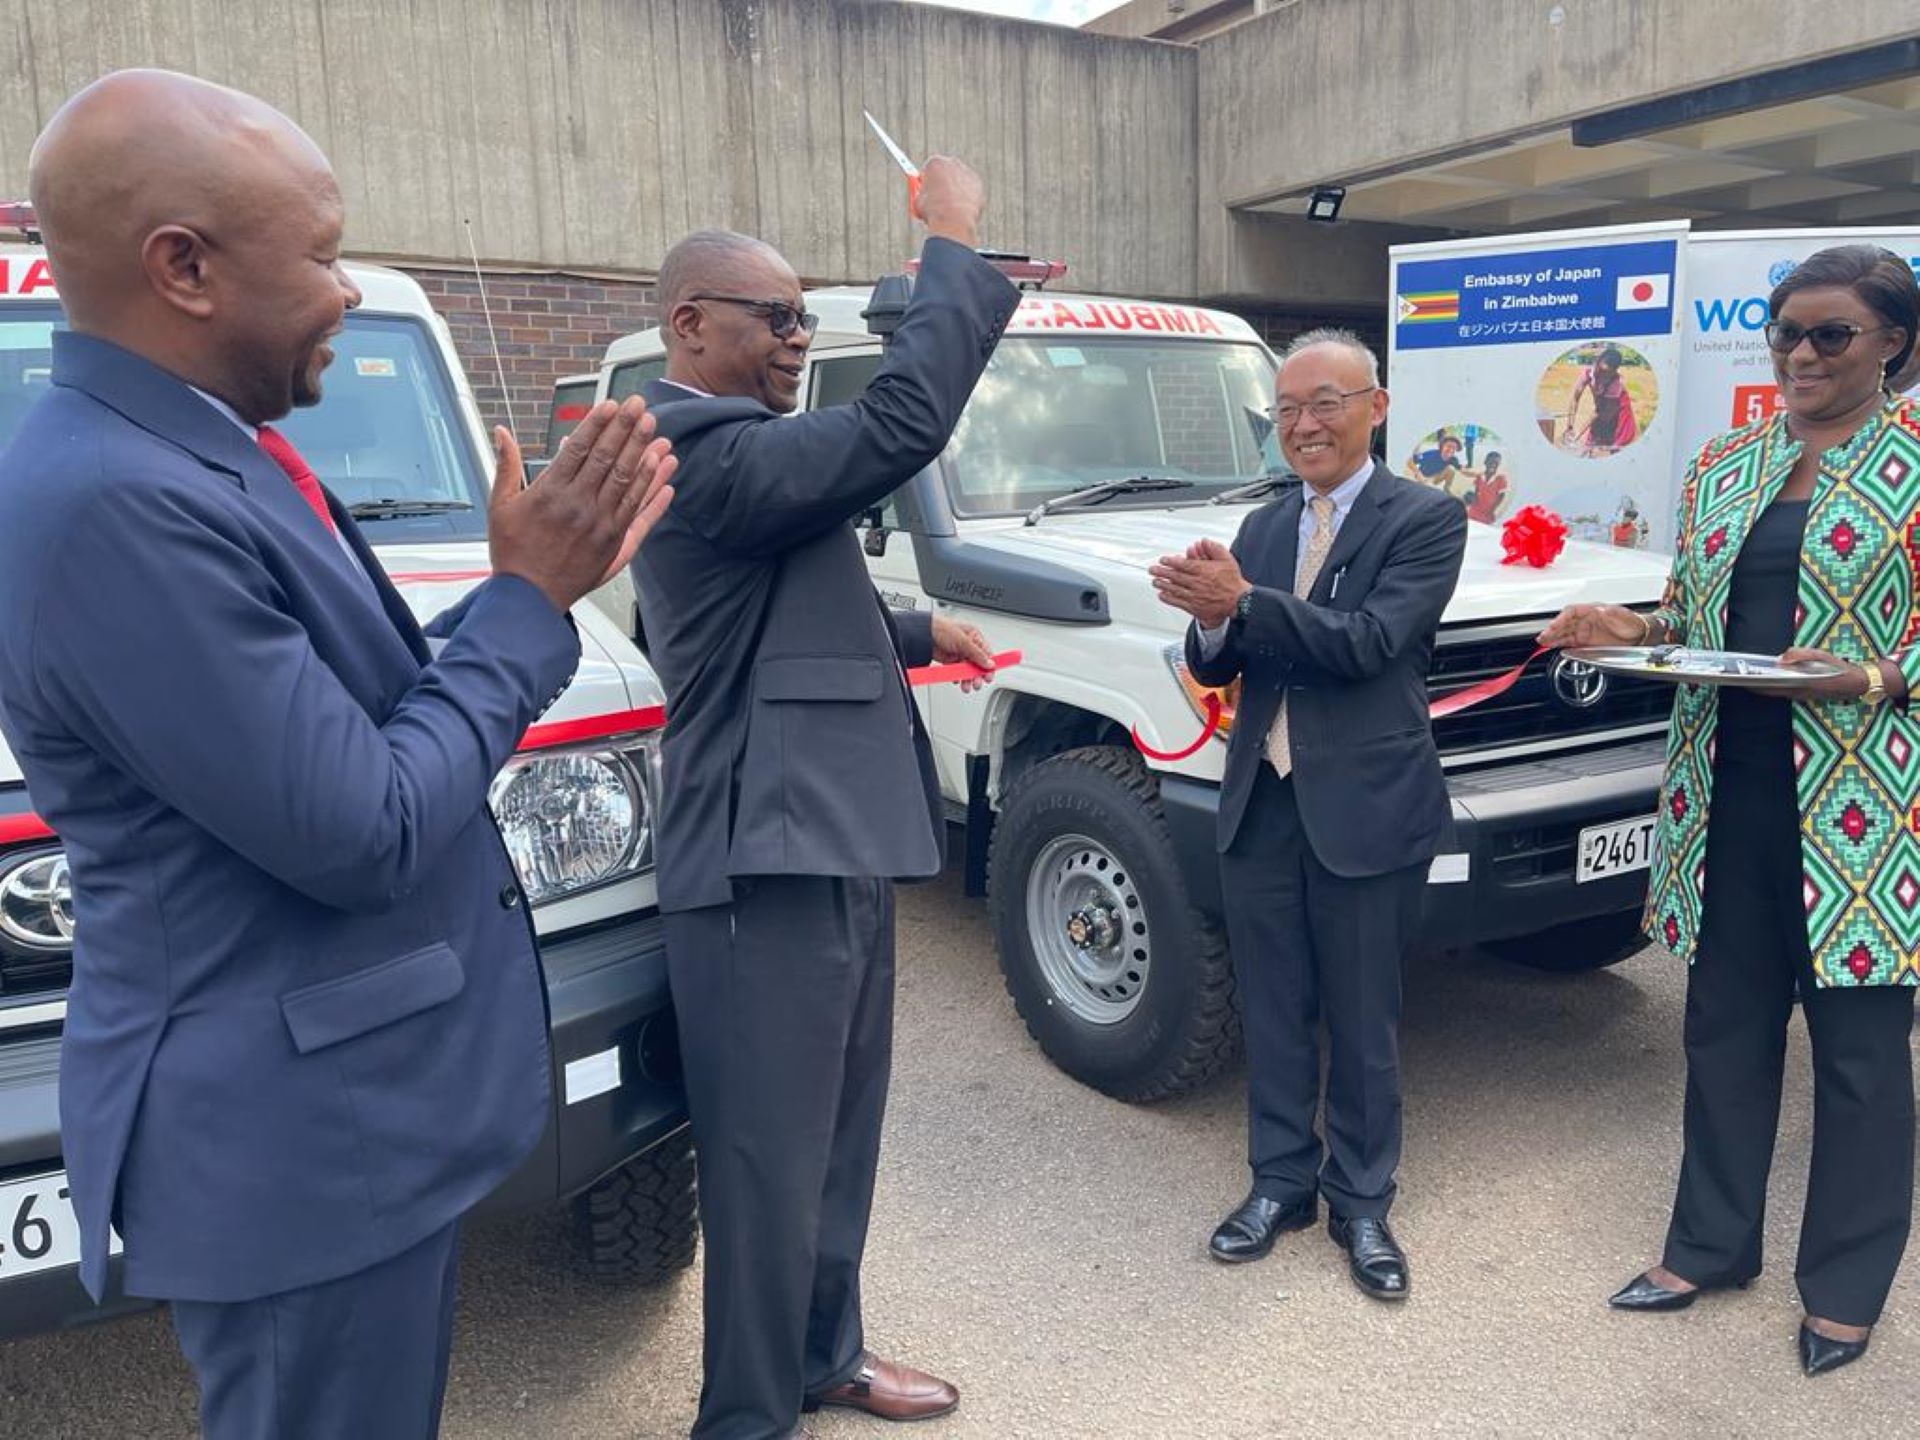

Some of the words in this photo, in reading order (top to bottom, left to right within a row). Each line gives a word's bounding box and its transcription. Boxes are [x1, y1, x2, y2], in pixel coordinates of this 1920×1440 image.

[1464, 273, 1532, 288] Embassy
[1536, 269, 1552, 283] of
[1555, 267, 1602, 283] Japan
[1484, 297, 1498, 310] in
[1501, 292, 1579, 309] Zimbabwe
[1694, 297, 1770, 332] WO
[1459, 316, 1606, 338] 在ジンバブエ日本国大使館
[1694, 340, 1732, 352] United
[1735, 340, 1768, 352] Natio
[1734, 356, 1755, 366] and
[1759, 356, 1770, 366] th
[1747, 394, 1763, 423] 5
